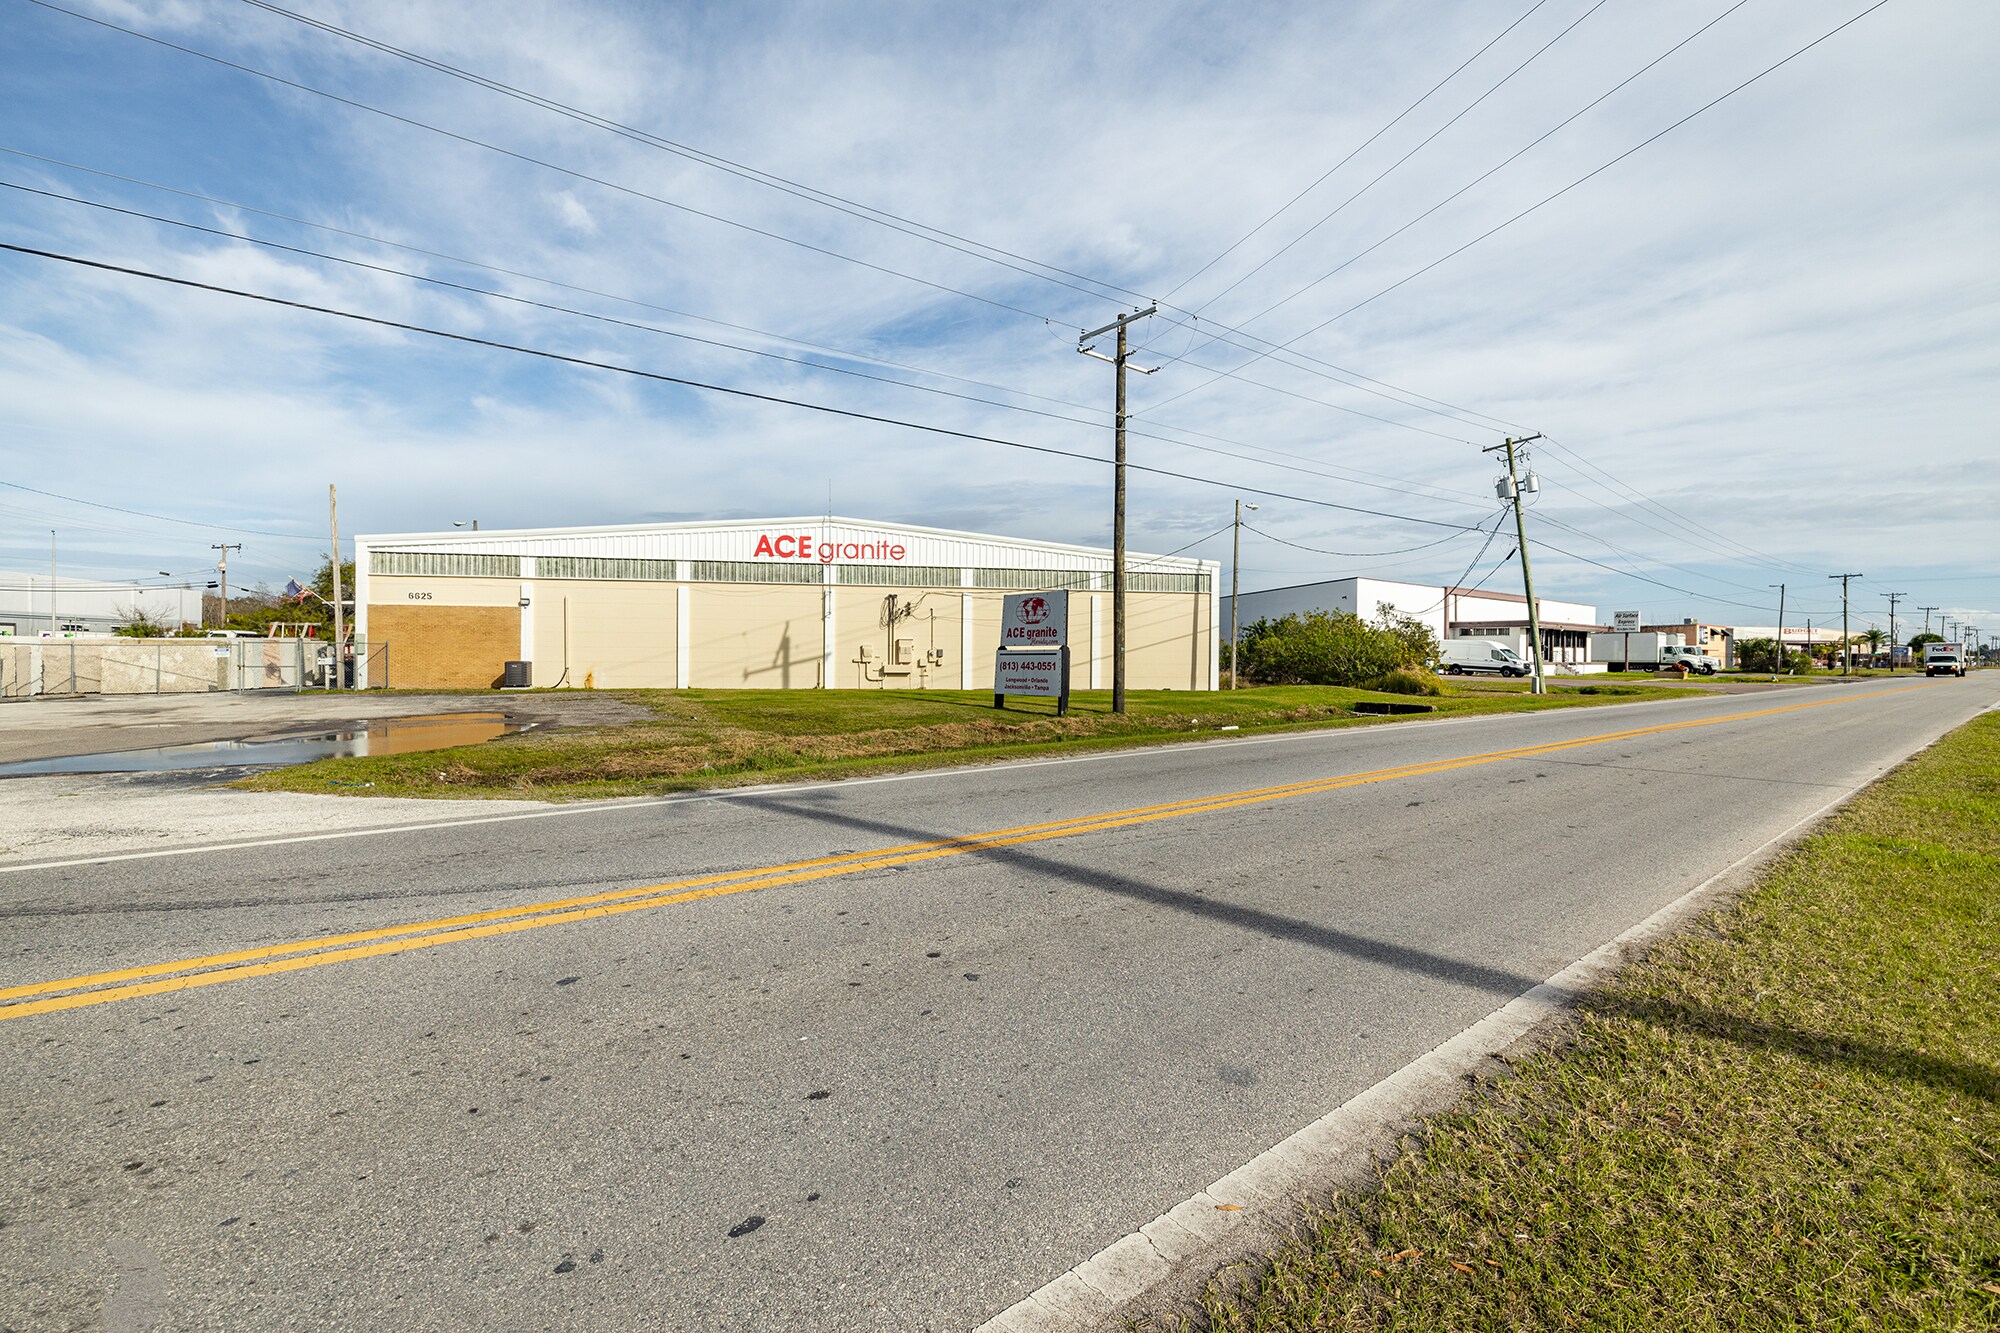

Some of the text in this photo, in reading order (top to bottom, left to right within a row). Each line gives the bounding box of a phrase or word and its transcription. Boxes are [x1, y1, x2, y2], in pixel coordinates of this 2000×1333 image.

[753, 534, 906, 564] ACE granite
[408, 592, 433, 600] 6625
[1006, 626, 1058, 640] ACE granite
[999, 661, 1057, 672] (813) 443-0551
